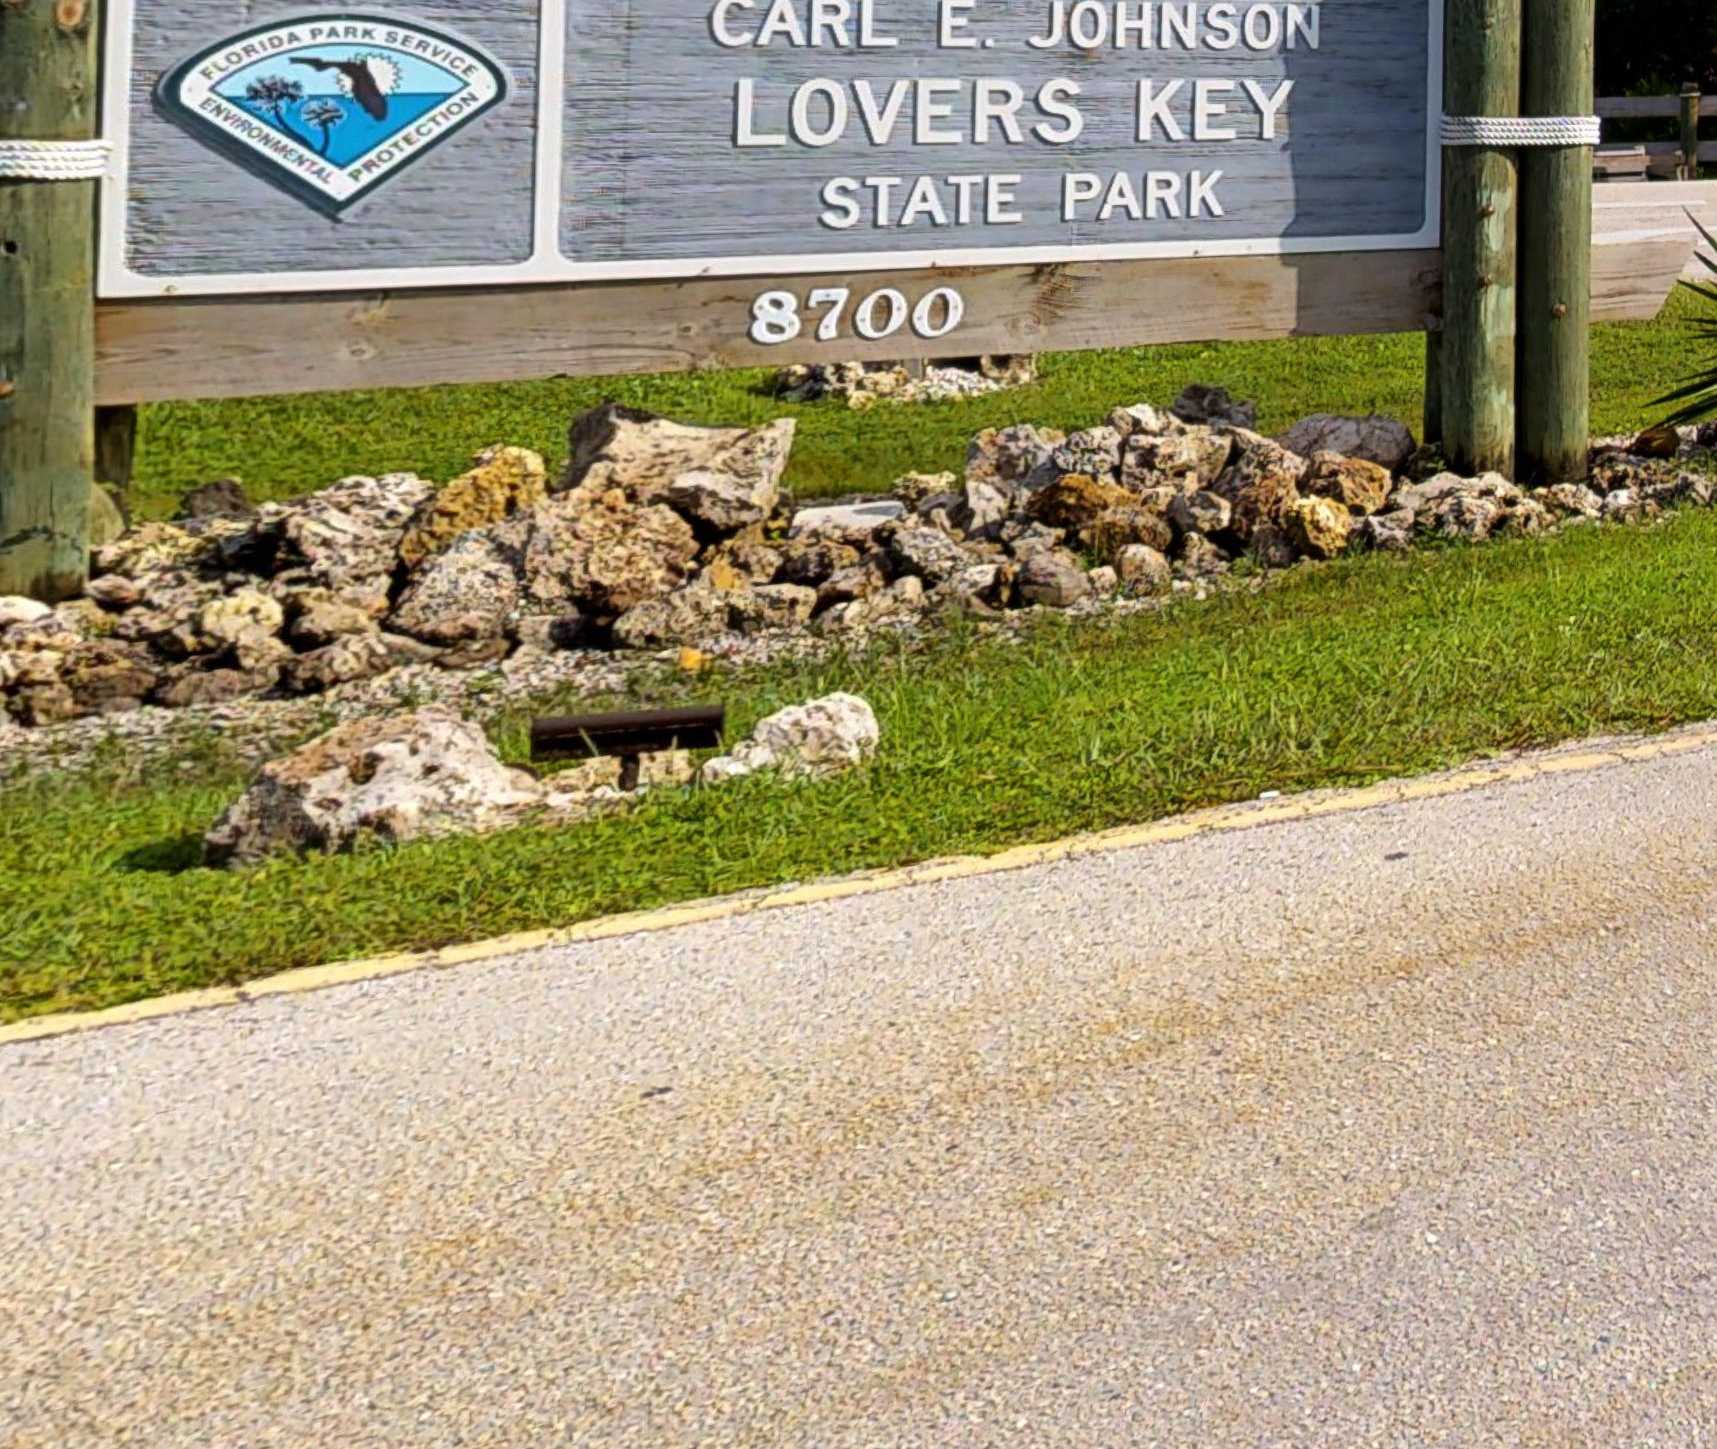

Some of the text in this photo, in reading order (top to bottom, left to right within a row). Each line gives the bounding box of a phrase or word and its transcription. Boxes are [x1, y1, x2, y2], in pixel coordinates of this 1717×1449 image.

[201, 26, 479, 80] FLORIDA PARK SERVICE
[199, 90, 480, 185] ENVIRONMENTAL PROTECTION
[735, 77, 1296, 147] LOVERS KEY
[821, 169, 1226, 228] STATE PARK
[750, 287, 965, 343] 8700
